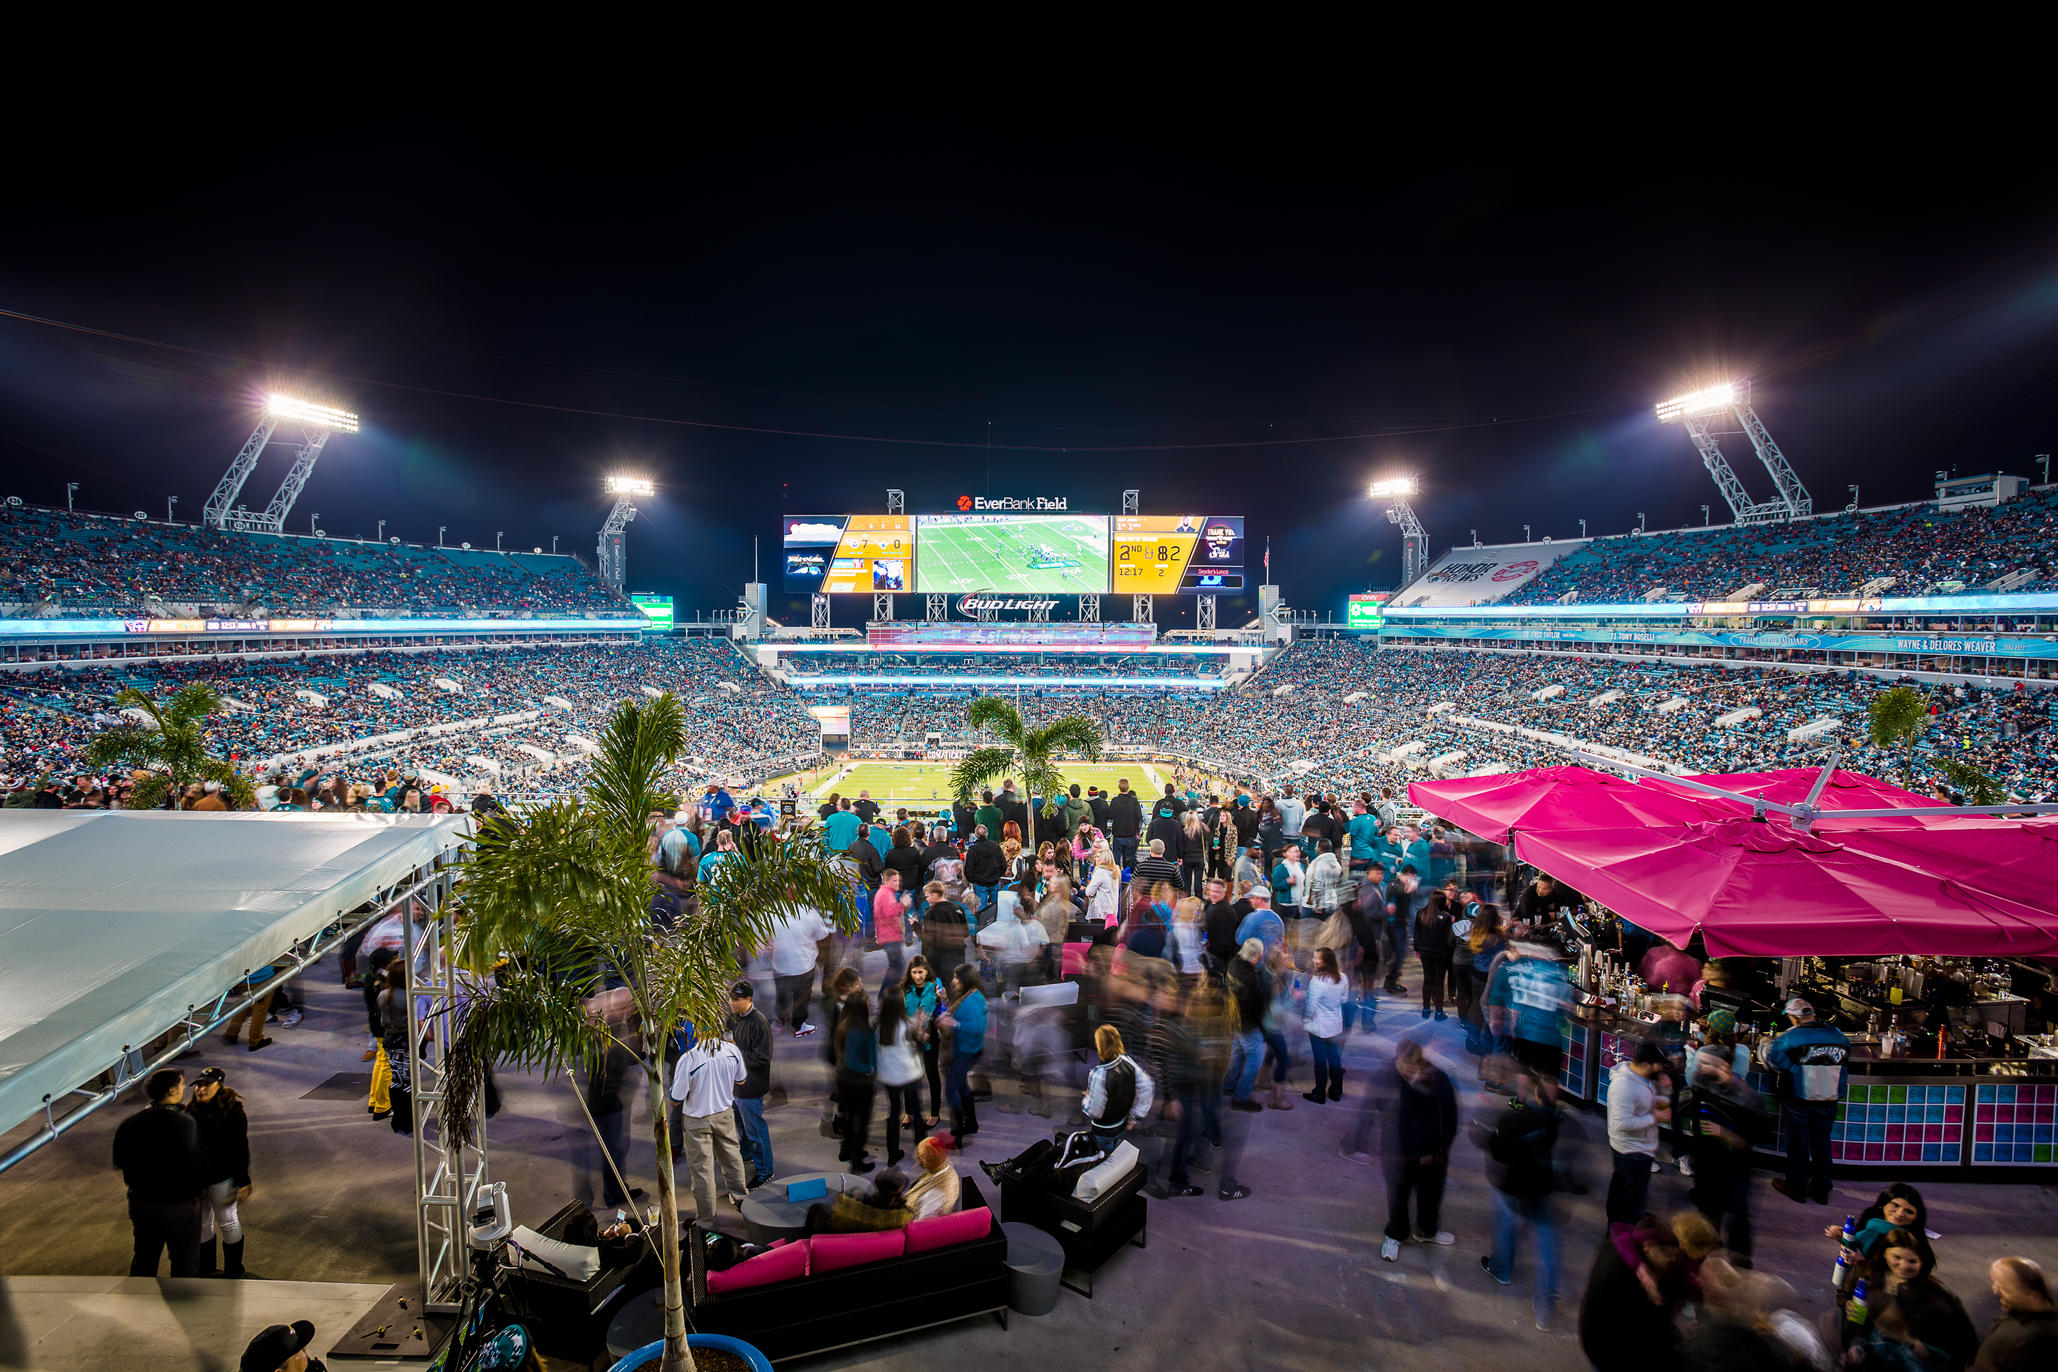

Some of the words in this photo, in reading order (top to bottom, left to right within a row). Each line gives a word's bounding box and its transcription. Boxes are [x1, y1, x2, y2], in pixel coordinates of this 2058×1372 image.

[974, 496, 1035, 510] EverBank
[1036, 496, 1068, 510] Field
[963, 599, 1004, 610] BUD
[1004, 599, 1059, 610] LIGHT
[1897, 639, 1921, 650] WAYNE
[1923, 640, 1929, 650] &
[1930, 640, 1962, 652] DELORES
[1964, 641, 1997, 653] WEAVER
[1800, 1046, 1847, 1064] JAGUARS
